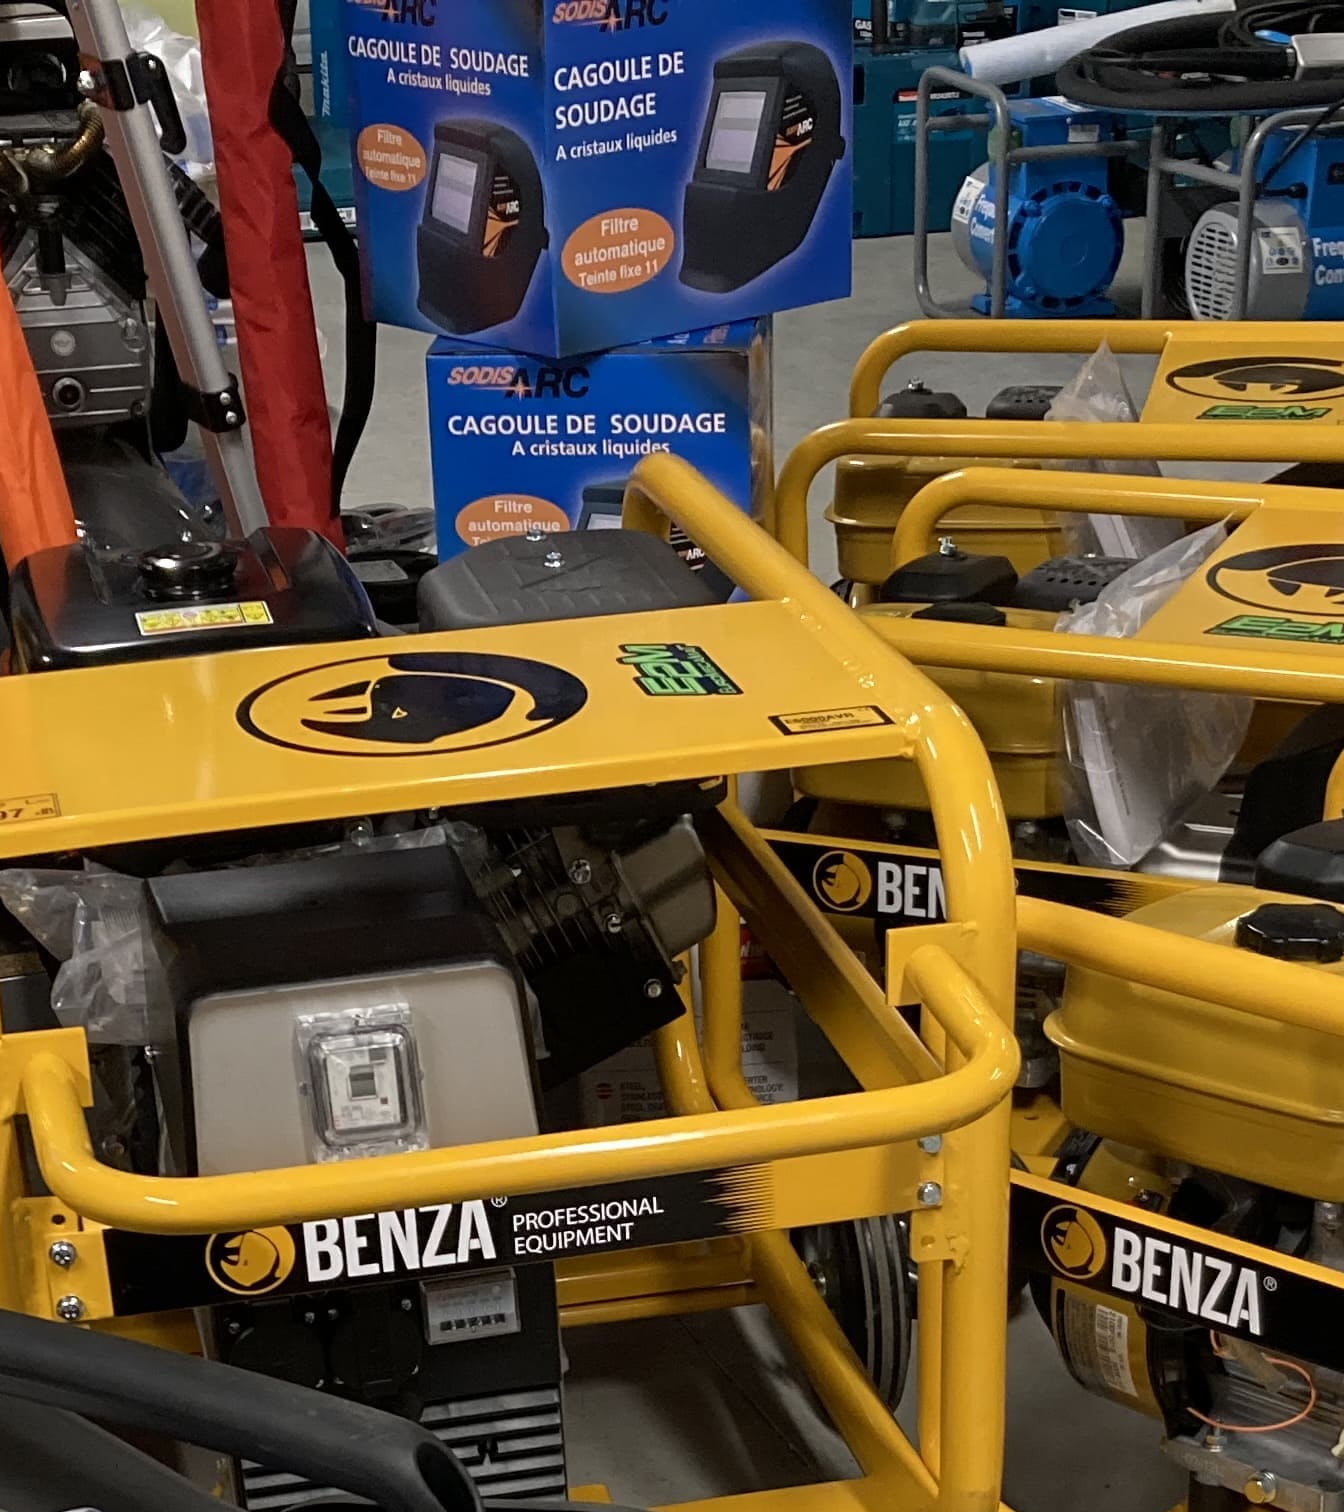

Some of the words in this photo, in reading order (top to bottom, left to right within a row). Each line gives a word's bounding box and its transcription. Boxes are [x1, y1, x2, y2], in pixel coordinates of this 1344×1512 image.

[348, 36, 416, 64] CAGOULE
[421, 45, 441, 67] DE
[450, 48, 529, 77] SOUDAGE
[554, 55, 652, 91] CAGOULE
[658, 51, 684, 77] DE
[387, 68, 396, 84] A
[398, 71, 442, 90] cristaux
[445, 74, 491, 96] liquides
[555, 92, 656, 130] SOUDAGE
[377, 129, 402, 147] Filtre
[556, 145, 567, 161] A
[570, 136, 623, 159] cristaux
[626, 128, 678, 153] liquides
[363, 150, 421, 169] automatique
[601, 217, 639, 237] Filtre
[574, 237, 666, 267] automatique
[578, 269, 617, 288] Teinte
[620, 265, 642, 280] fixe
[645, 259, 658, 275] 11
[448, 414, 558, 436] CAGOULE
[566, 414, 596, 435] DE
[610, 413, 726, 434] SOUDAGE
[512, 441, 525, 456] A
[530, 440, 597, 456] cristaux
[603, 440, 670, 458] liquides
[494, 501, 533, 514] Filtre
[468, 518, 561, 533] automatique
[877, 861, 946, 920] BEN
[513, 1197, 664, 1232] PROFESSIONAL
[514, 1222, 634, 1255] EQUIPMENT
